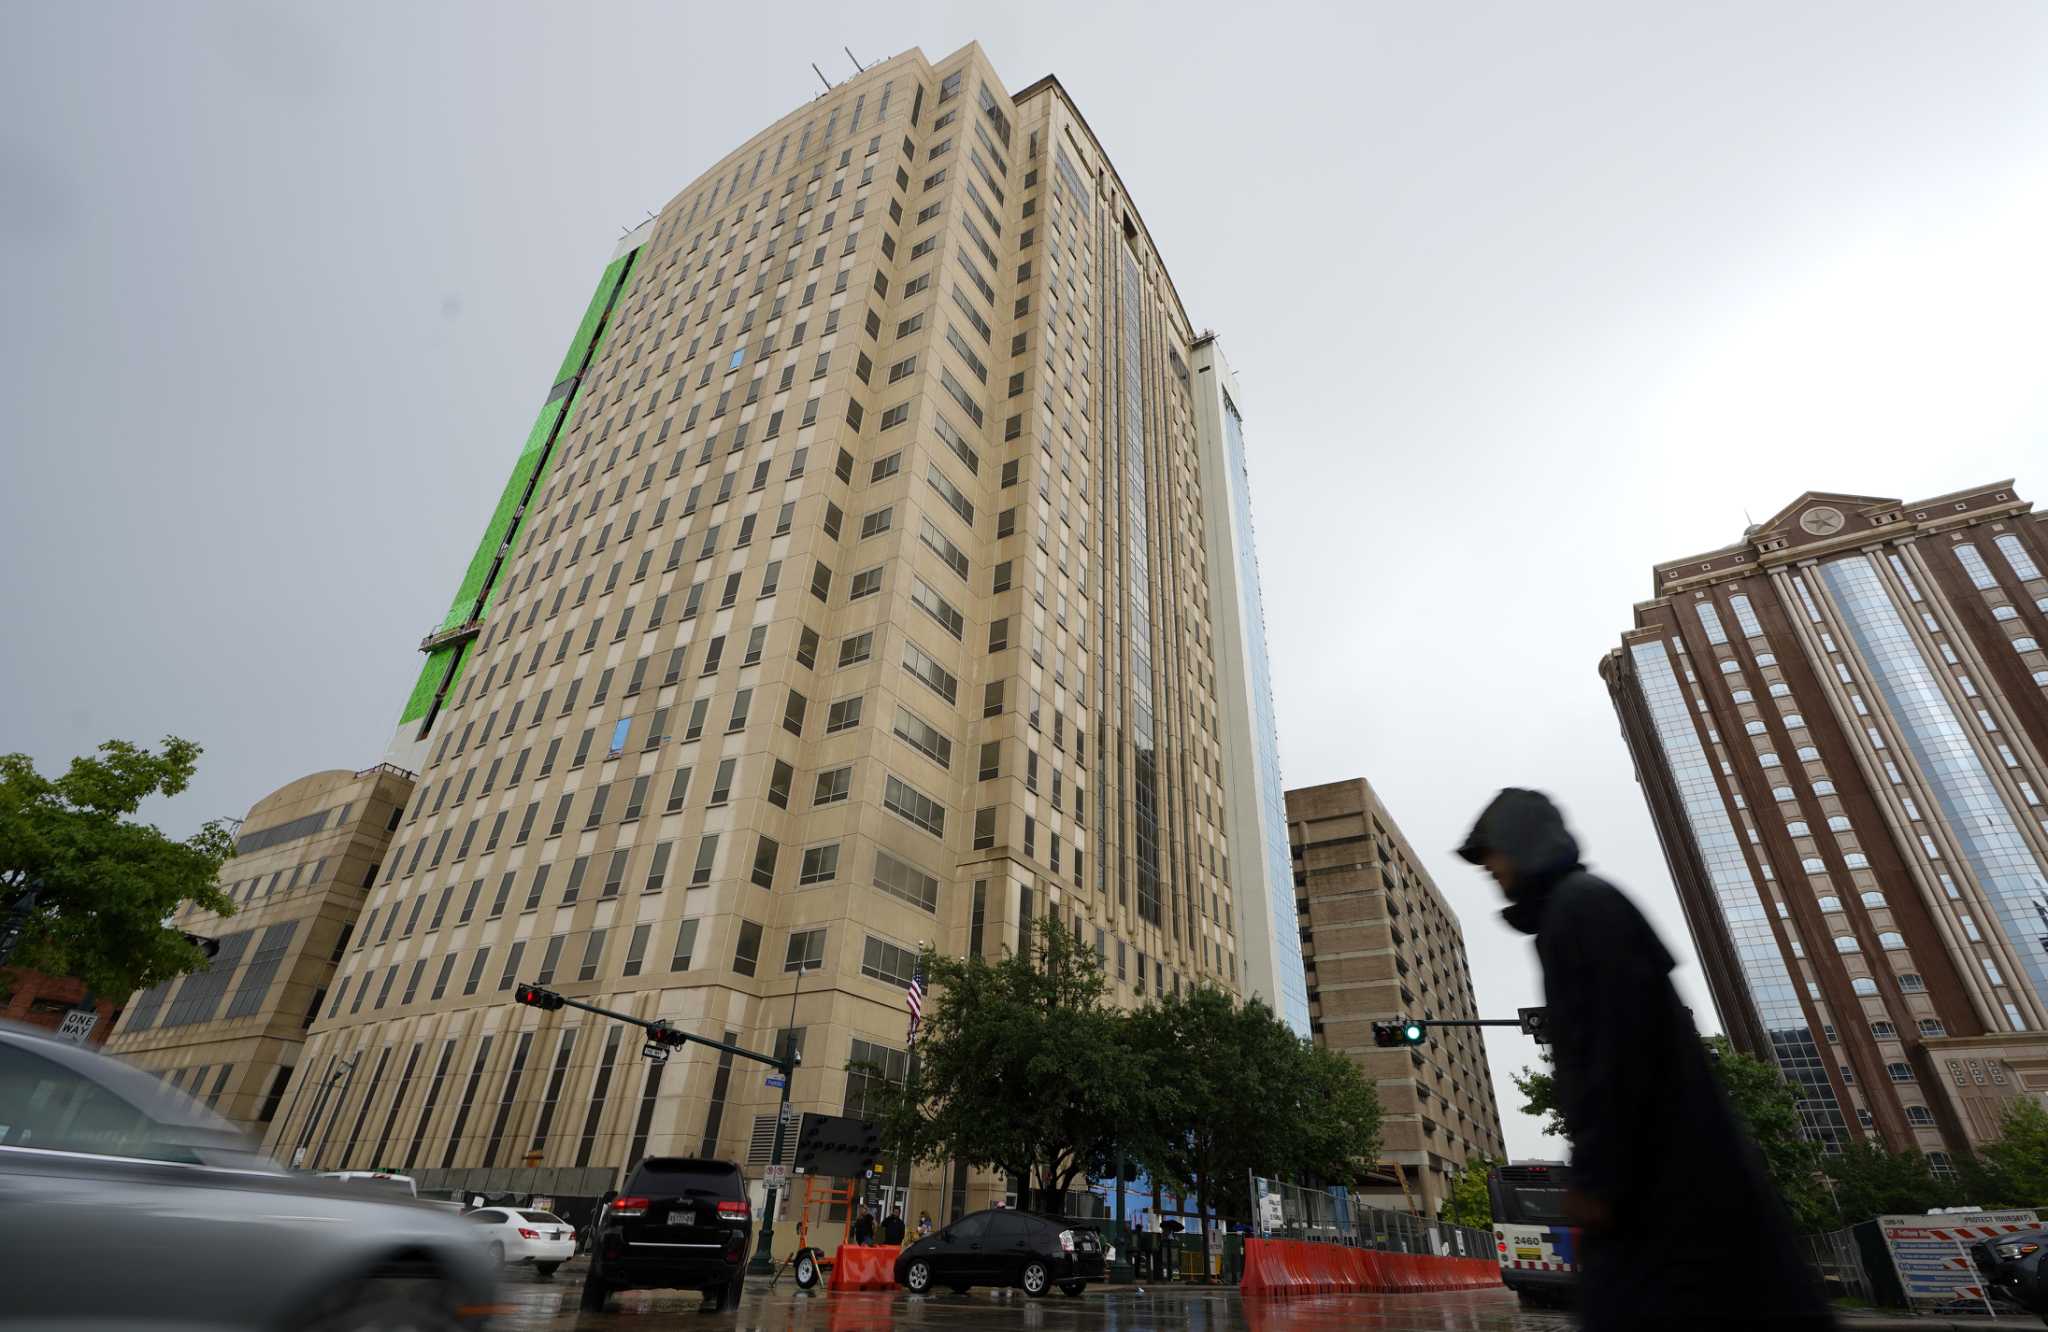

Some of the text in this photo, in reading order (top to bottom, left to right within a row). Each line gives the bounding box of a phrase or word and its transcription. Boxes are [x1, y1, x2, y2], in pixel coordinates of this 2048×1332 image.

[68, 1014, 94, 1025] ONE
[62, 1023, 91, 1035] WAY
[1514, 1236, 1540, 1246] 2460
